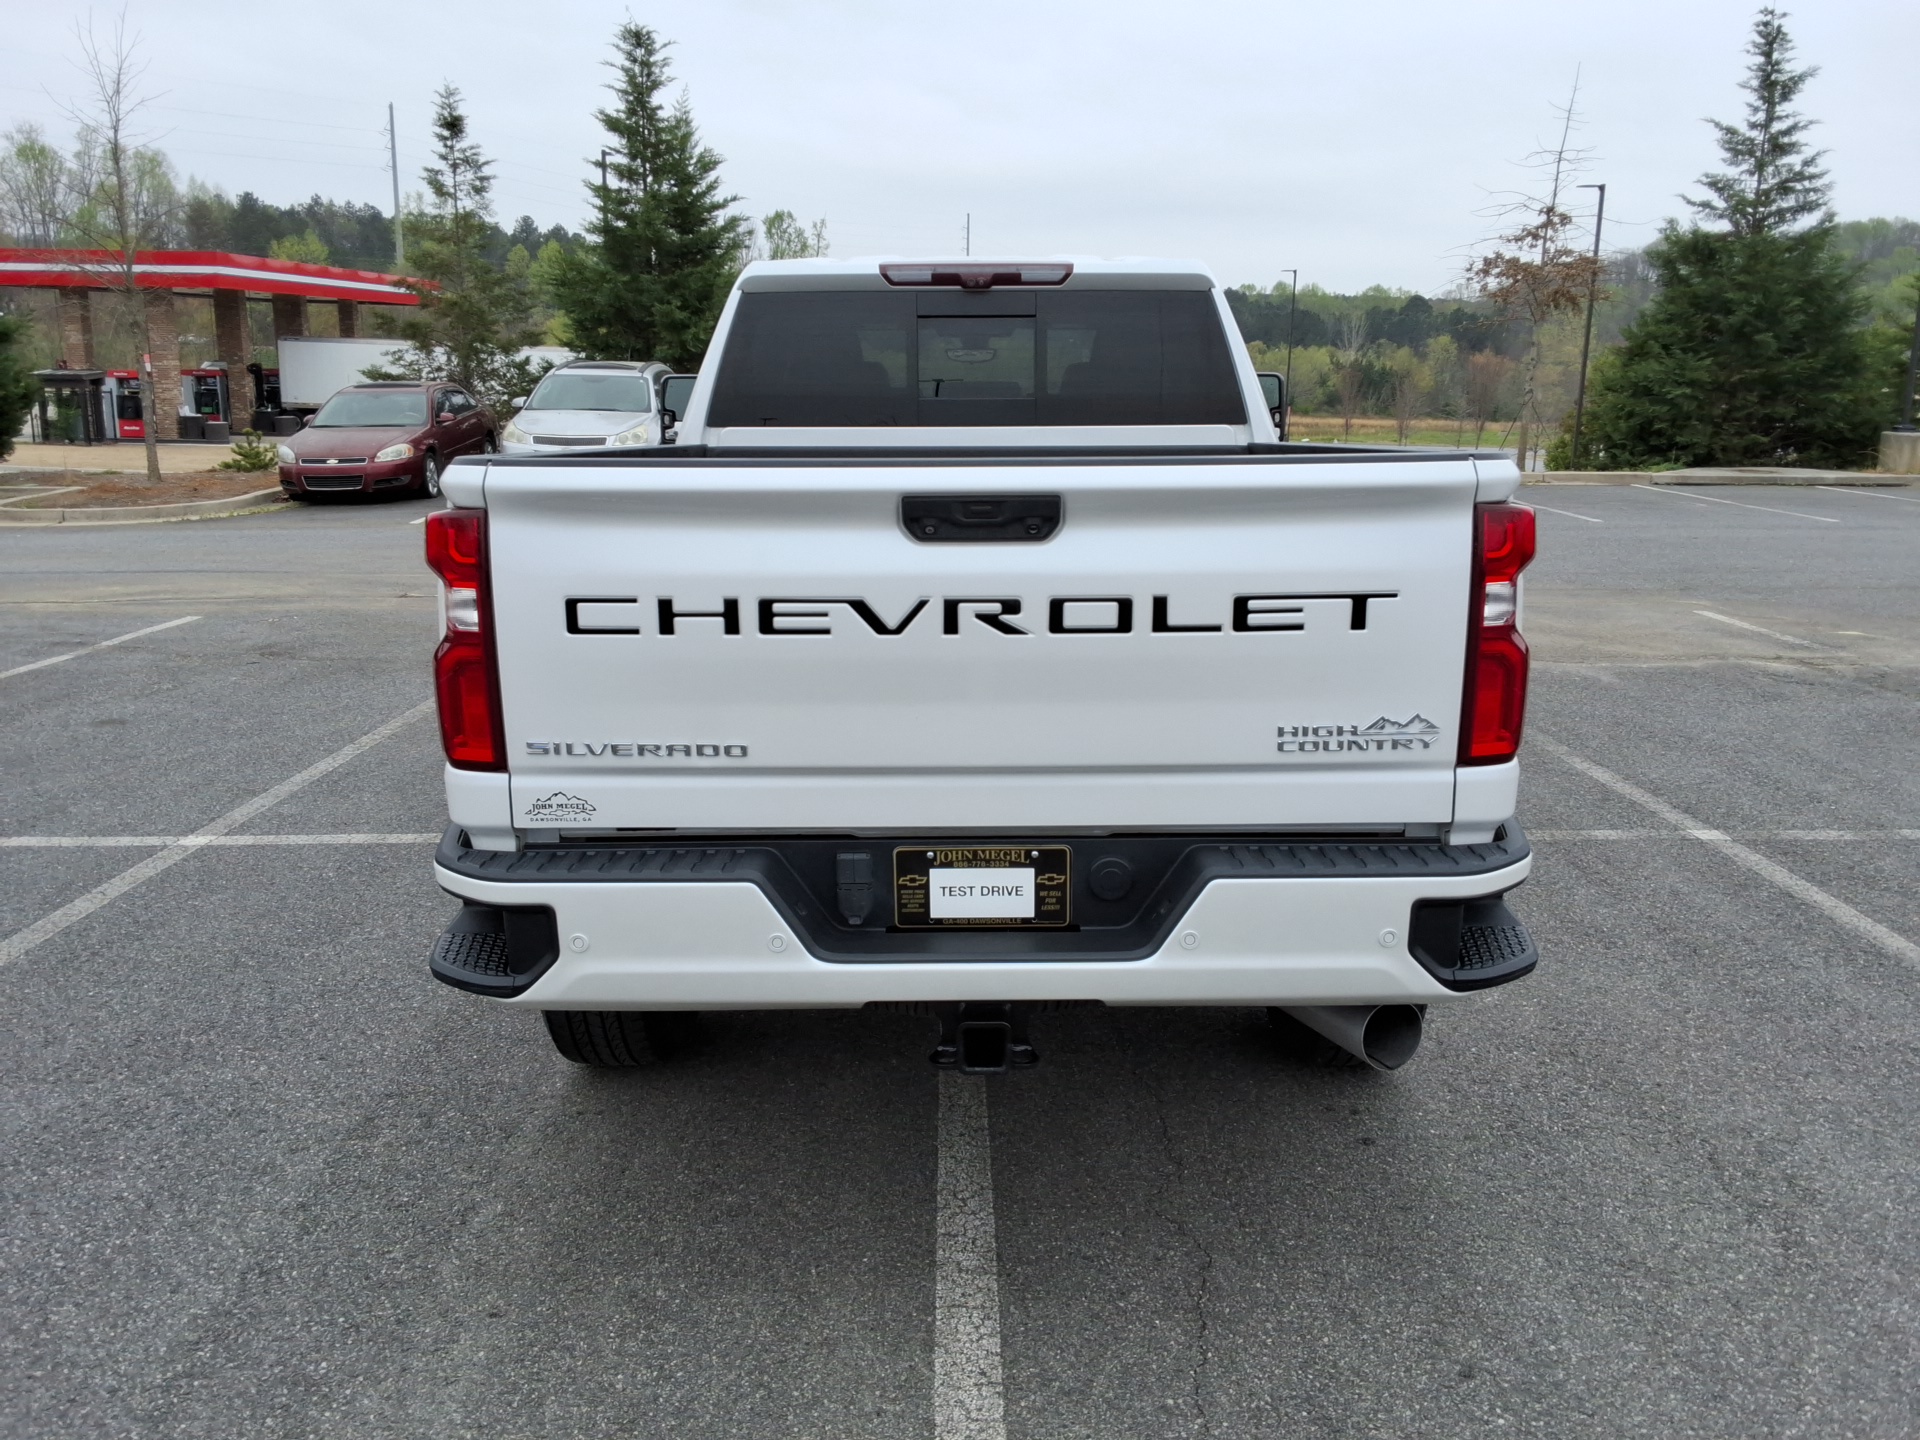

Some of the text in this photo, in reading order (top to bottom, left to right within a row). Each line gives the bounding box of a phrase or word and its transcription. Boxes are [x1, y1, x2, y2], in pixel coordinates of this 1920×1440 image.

[564, 592, 1399, 636] CHEVROLET
[1277, 724, 1359, 738] HIGH
[526, 740, 749, 758] SILVERADO
[1277, 736, 1438, 752] COUNTRY
[532, 803, 588, 813] JOHN MEGEL
[934, 849, 1030, 866] JOHN MEGEL
[939, 885, 976, 897] TEST
[980, 885, 1024, 897] DRIVE
[969, 917, 1022, 925] DAWSONVILLE
